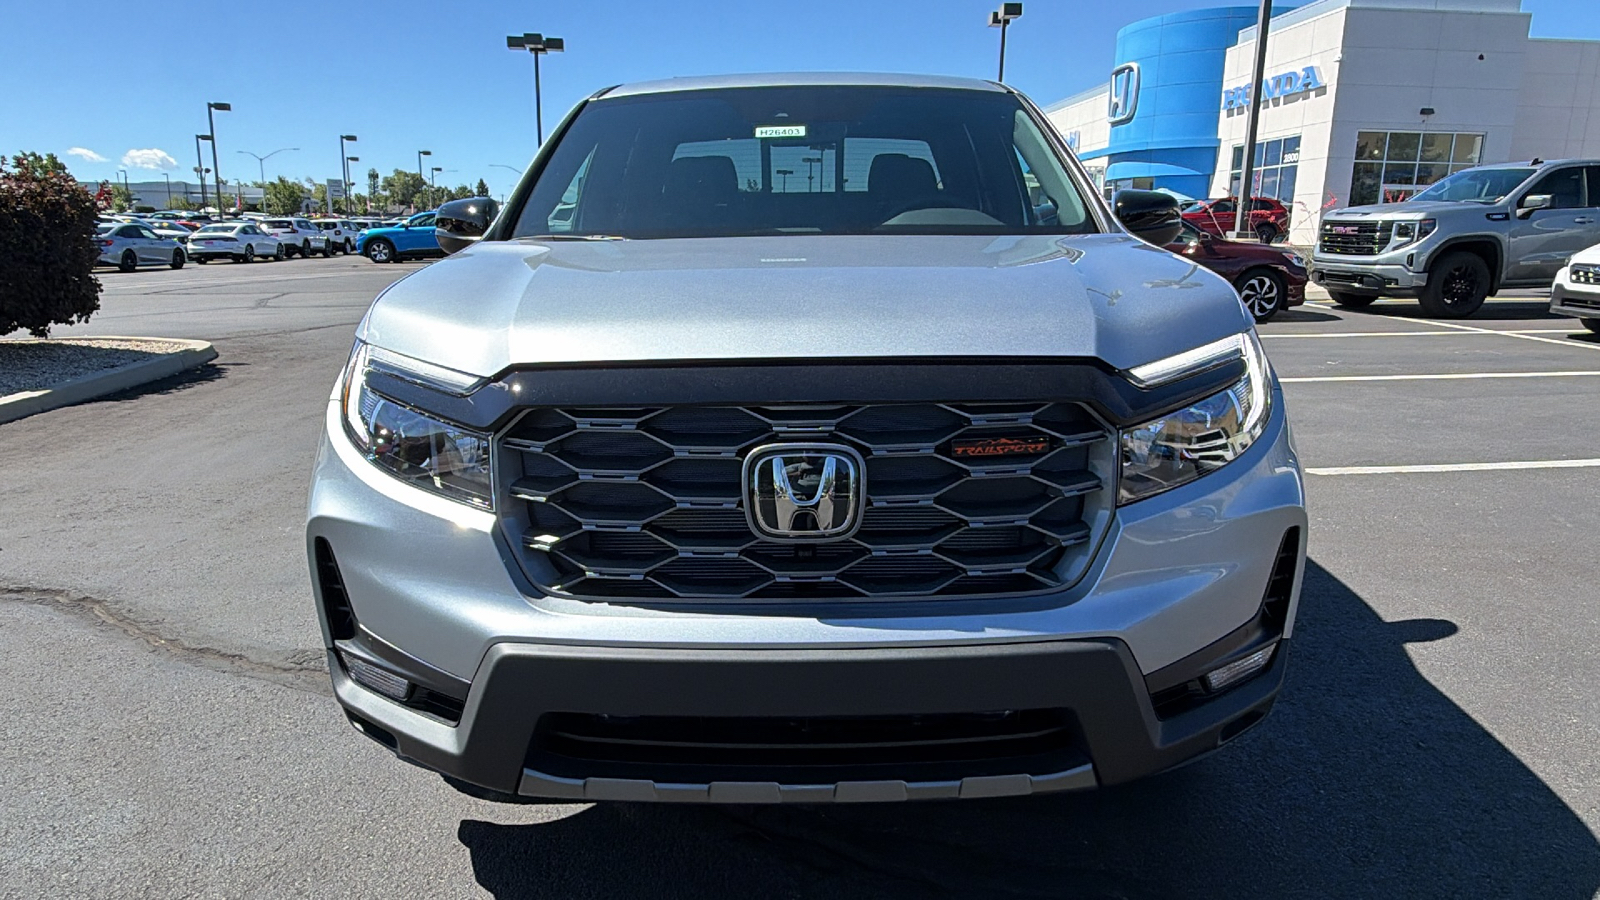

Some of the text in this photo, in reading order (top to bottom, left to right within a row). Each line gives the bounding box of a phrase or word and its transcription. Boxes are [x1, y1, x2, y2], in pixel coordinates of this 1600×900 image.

[1222, 65, 1322, 110] HONDA
[760, 128, 801, 136] H26403
[954, 442, 1047, 456] TRAILSPORT
